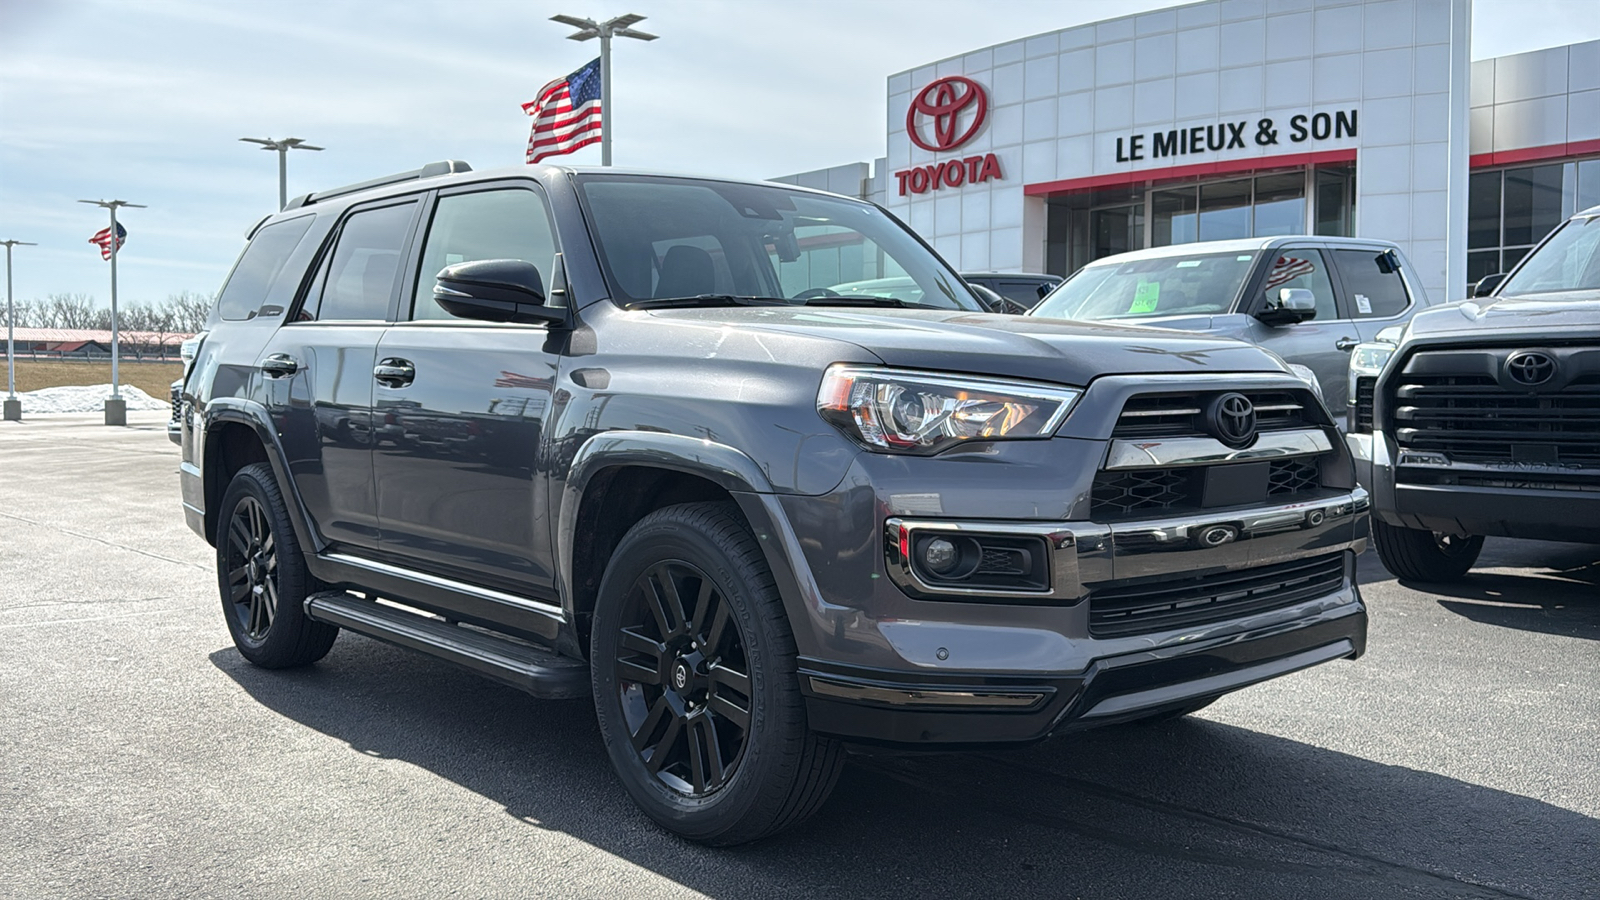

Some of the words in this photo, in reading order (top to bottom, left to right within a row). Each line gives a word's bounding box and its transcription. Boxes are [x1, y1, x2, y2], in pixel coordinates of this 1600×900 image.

[1116, 134, 1144, 163] LE
[1152, 121, 1246, 159] MIEUX
[1254, 118, 1278, 146] &
[1289, 109, 1357, 143] SON
[895, 153, 1003, 196] TOYOTA
